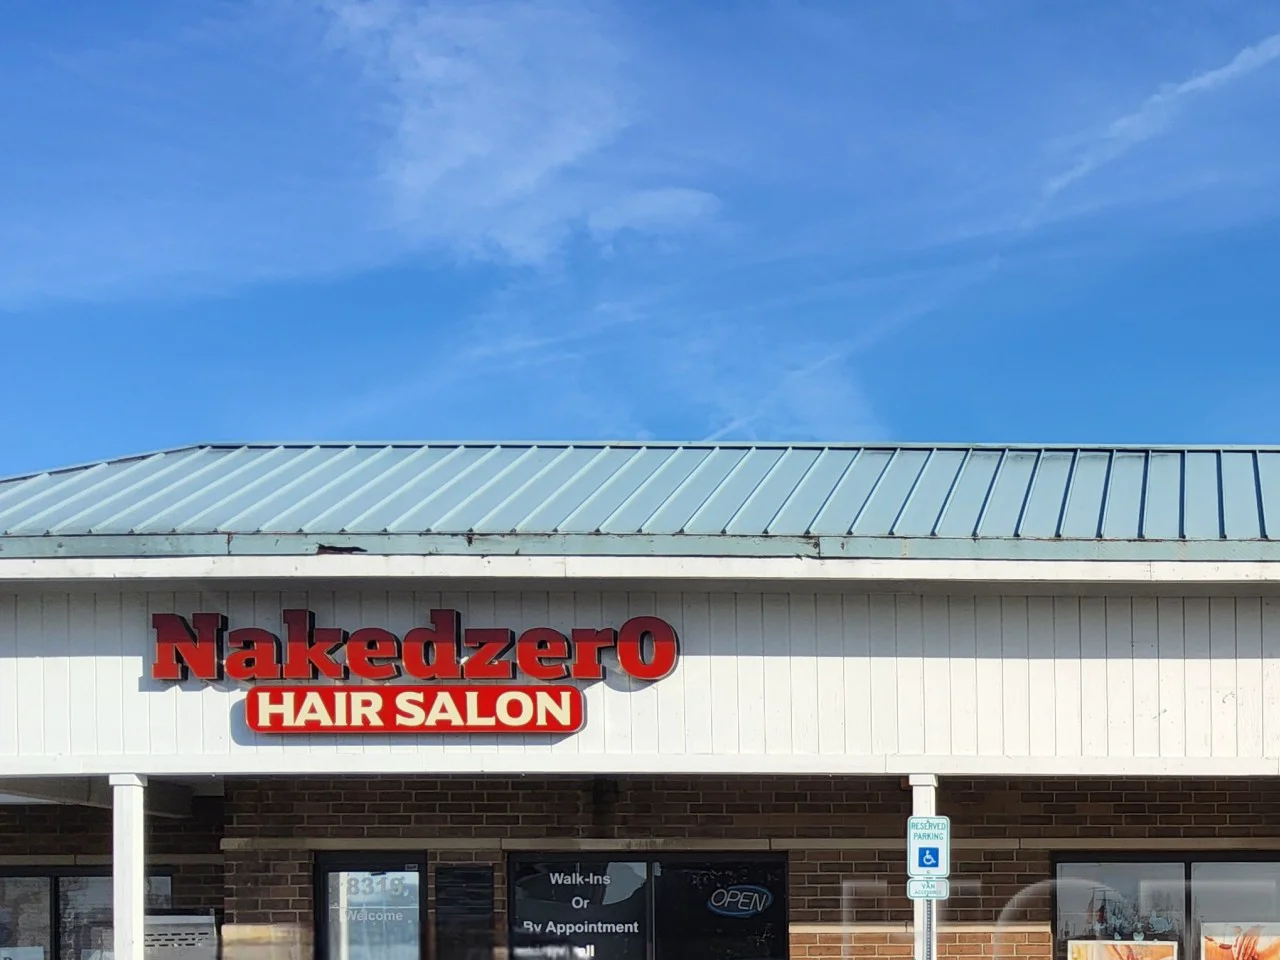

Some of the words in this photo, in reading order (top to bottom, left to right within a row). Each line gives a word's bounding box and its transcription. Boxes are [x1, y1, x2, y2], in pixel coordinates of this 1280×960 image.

[256, 692, 379, 728] HAIR
[395, 692, 572, 728] SALON
[911, 821, 946, 831] RESERVED
[913, 832, 944, 841] PARKING
[549, 872, 611, 885] Walk-Ins
[571, 896, 590, 909] Or
[711, 888, 767, 911] OPEN
[347, 910, 404, 921] Welcome
[545, 920, 639, 936] Appointment
